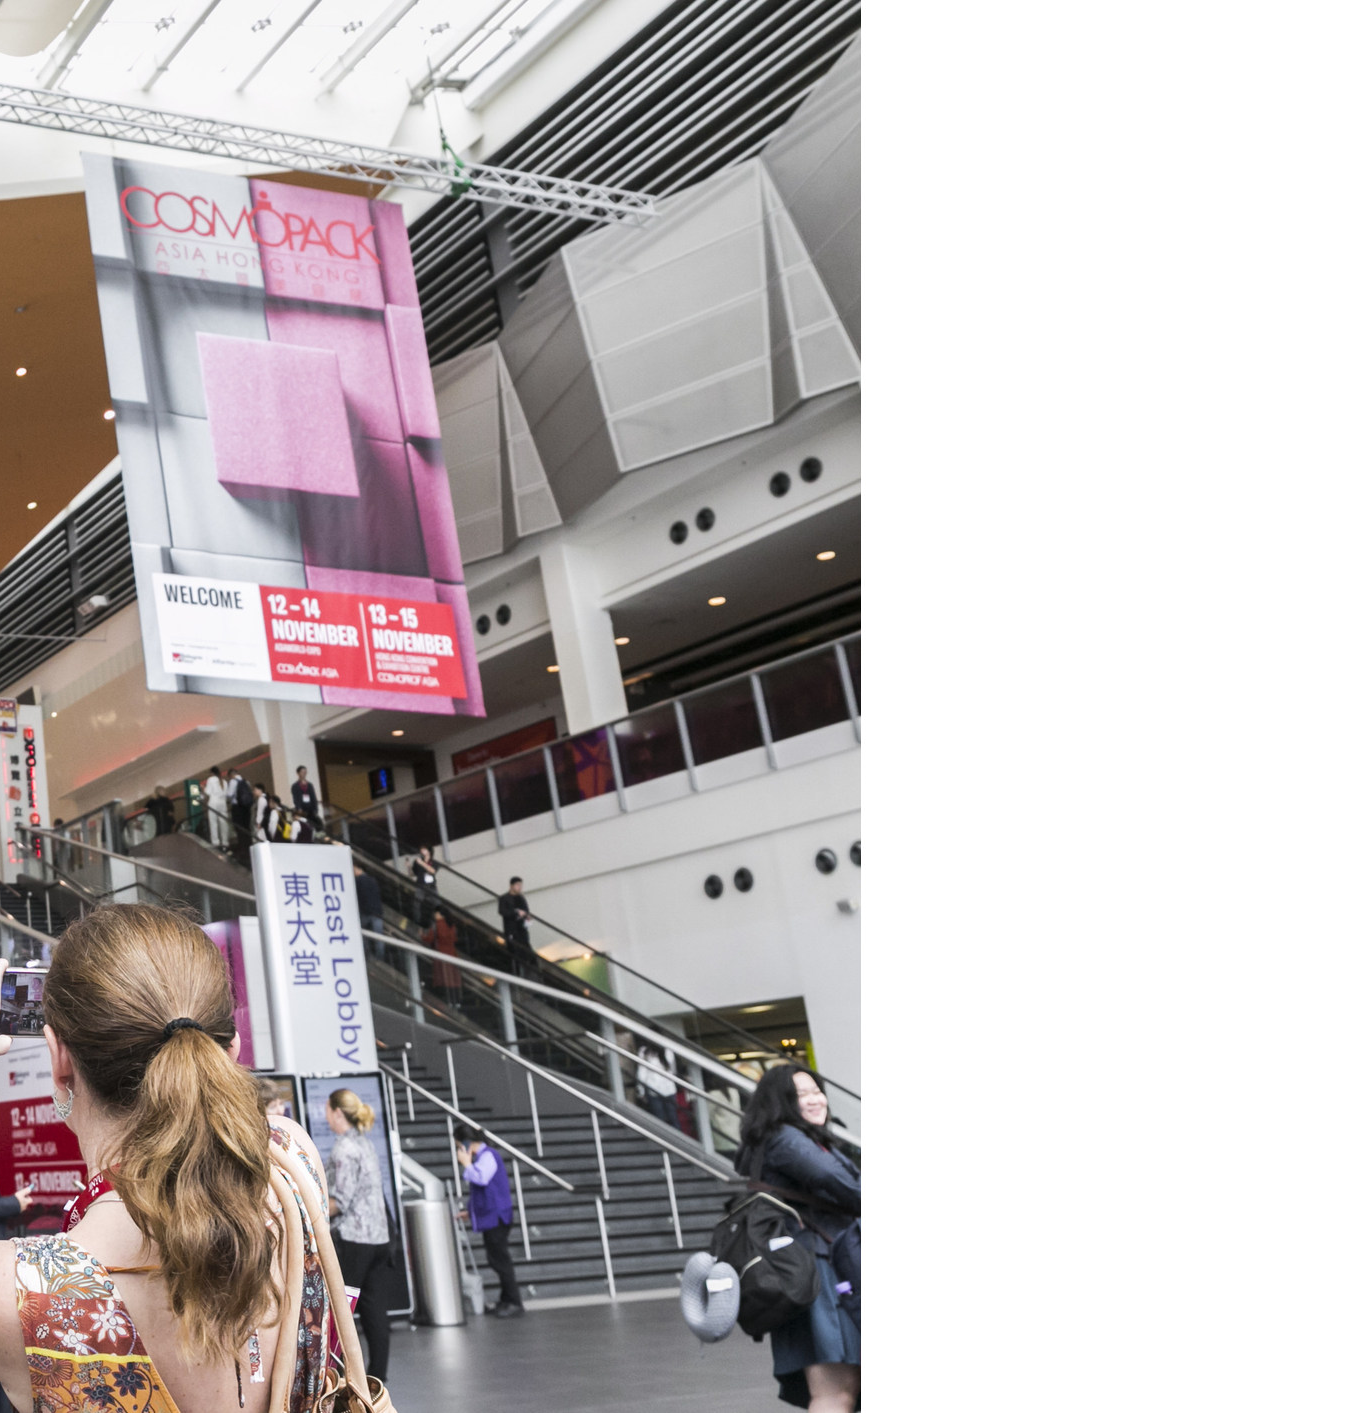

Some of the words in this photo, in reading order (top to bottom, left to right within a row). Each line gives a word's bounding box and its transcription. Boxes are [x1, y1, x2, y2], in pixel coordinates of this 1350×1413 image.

[120, 186, 380, 264] COSMOPACK
[155, 241, 206, 262] ASIA
[216, 250, 284, 273] HONG
[294, 261, 360, 284] KONG
[164, 583, 244, 610] WELCOME
[267, 594, 288, 616] 12
[301, 597, 321, 619] 14
[368, 603, 387, 625] 13
[399, 607, 418, 629] 15
[271, 618, 359, 647] NOVEMBER
[372, 628, 454, 657] NOVEMBER
[321, 872, 349, 944] East
[281, 872, 323, 986] 東大堂
[332, 958, 362, 1065] Lobby
[39, 1170, 81, 1193] NOVEMBER
